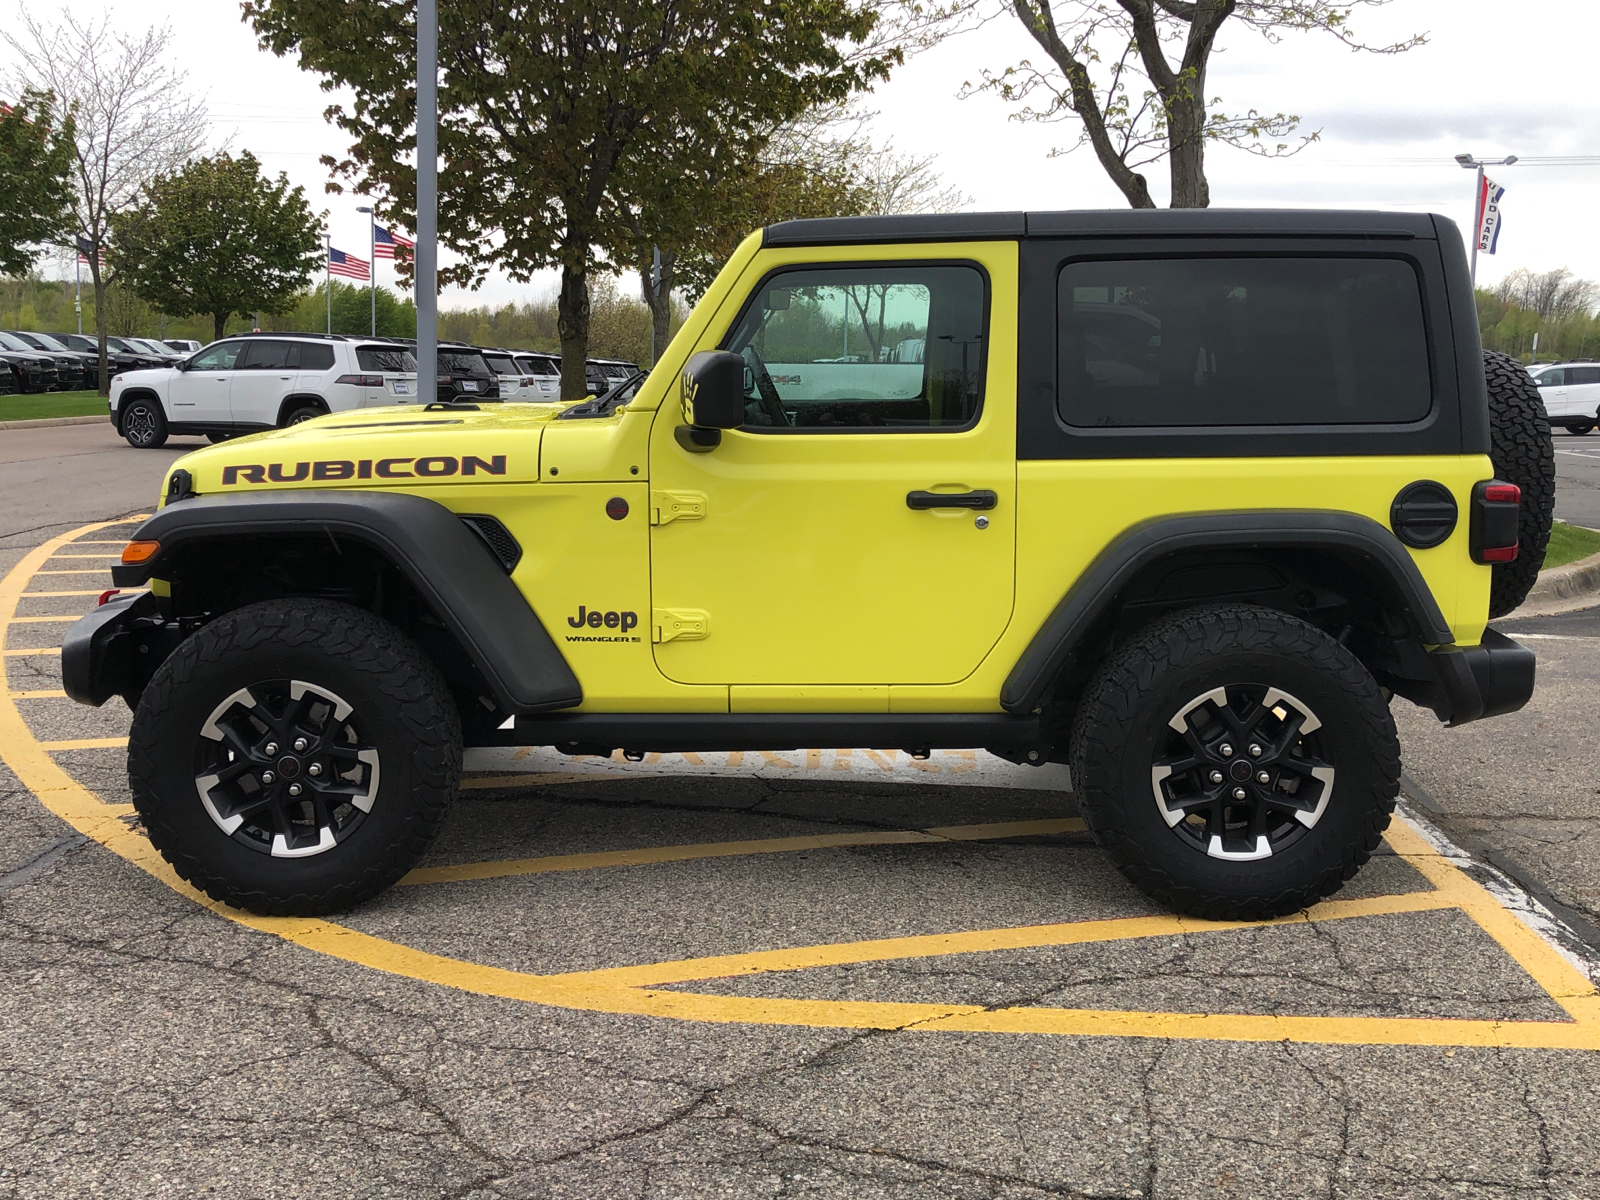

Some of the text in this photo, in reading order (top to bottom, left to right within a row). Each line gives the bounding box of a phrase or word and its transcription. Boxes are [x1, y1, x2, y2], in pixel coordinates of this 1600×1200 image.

[1480, 182, 1498, 250] UED CARS
[222, 455, 506, 485] RUBICON
[567, 605, 638, 633] Jeep
